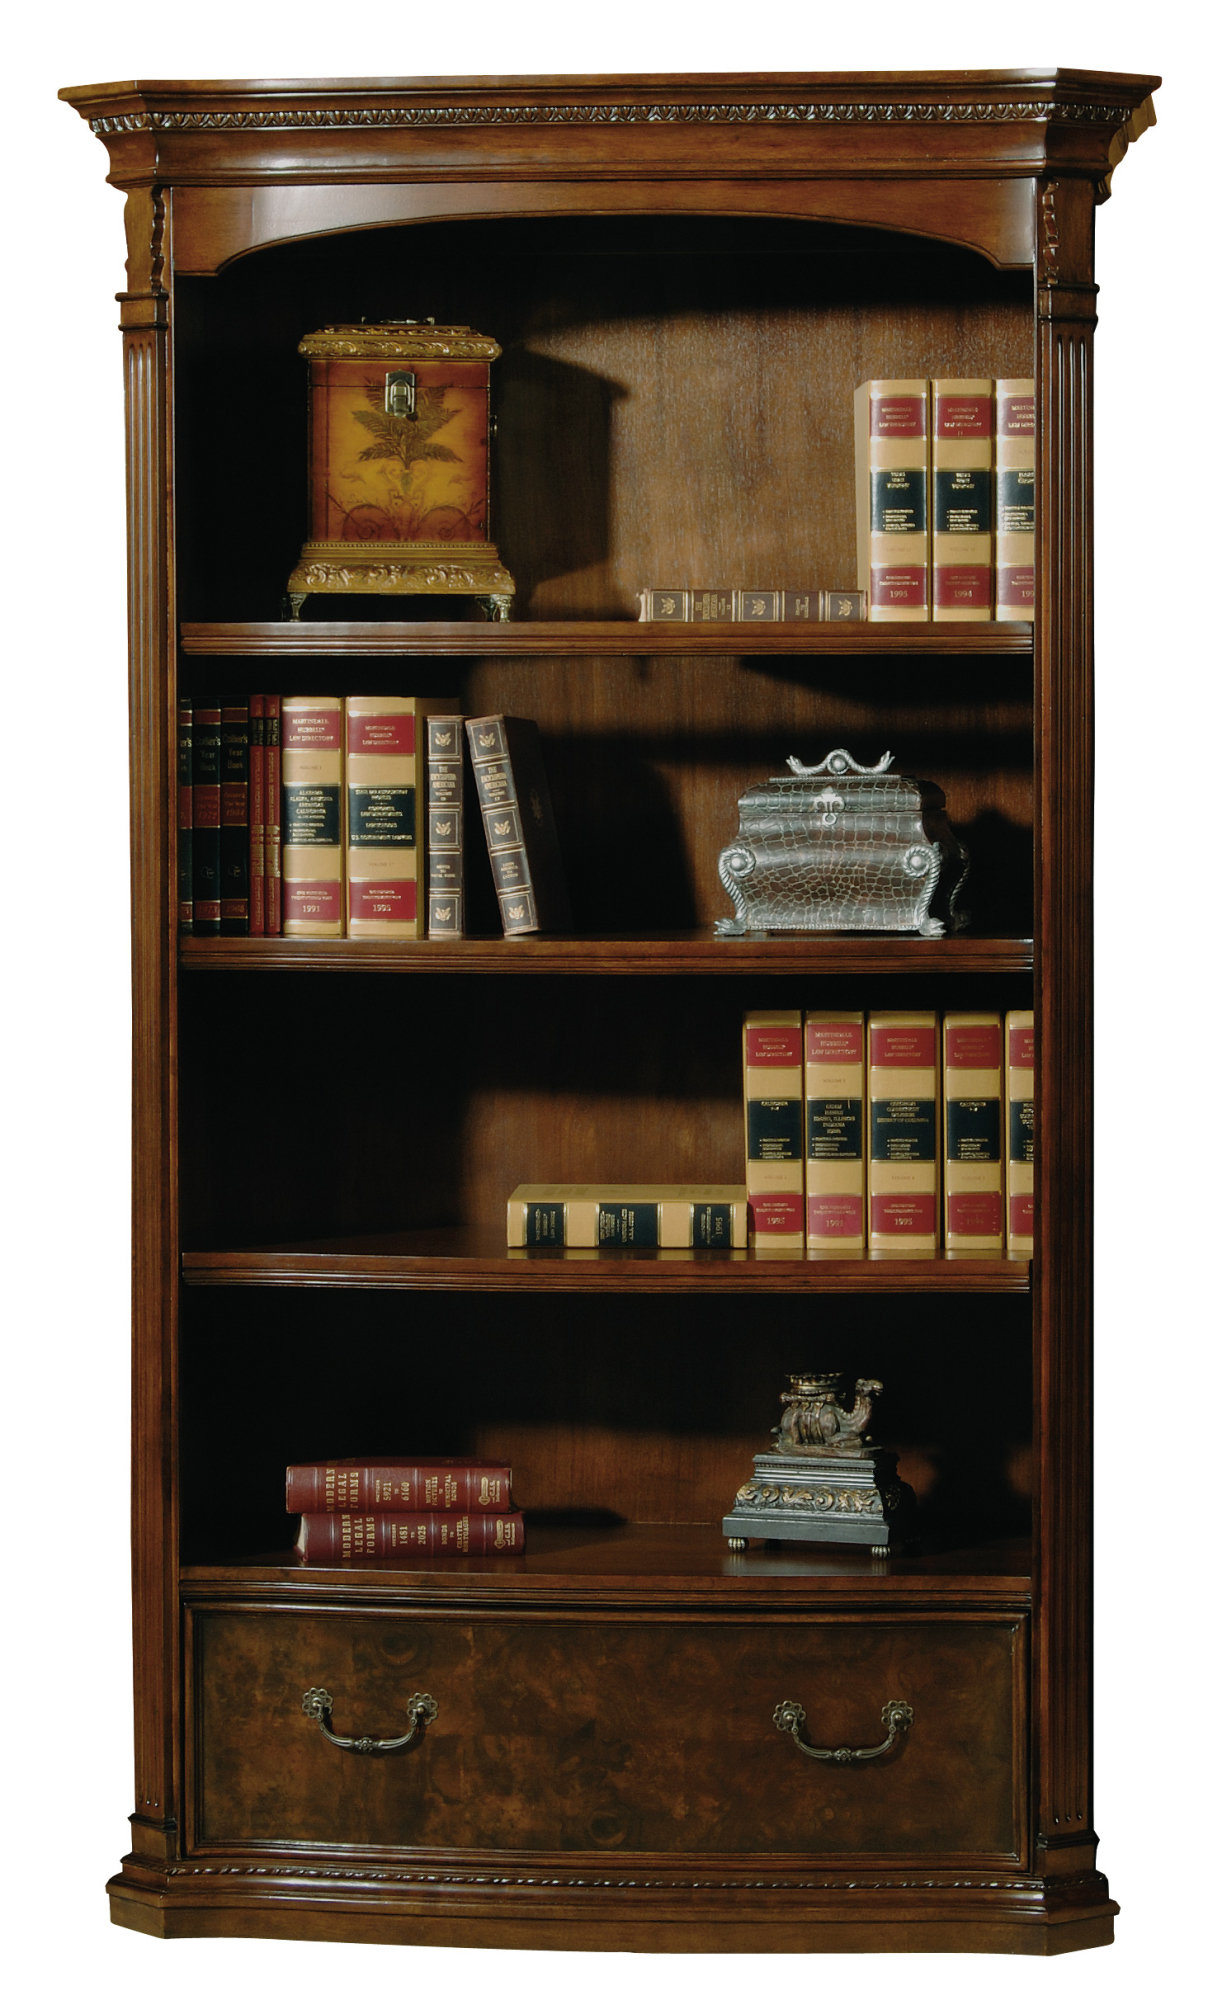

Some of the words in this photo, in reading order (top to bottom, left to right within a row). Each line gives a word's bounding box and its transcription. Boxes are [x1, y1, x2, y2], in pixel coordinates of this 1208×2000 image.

[1021, 590, 1034, 598] 199
[325, 1468, 335, 1512] MODERN
[338, 1473, 347, 1508] LEGAL
[349, 1472, 359, 1509] FORMS
[383, 1481, 392, 1501] 5921
[401, 1481, 410, 1501] 6160
[342, 1514, 351, 1558] MODERN
[354, 1518, 364, 1553] LEGAL
[366, 1517, 375, 1554] FORMS
[417, 1525, 426, 1545] 2025
